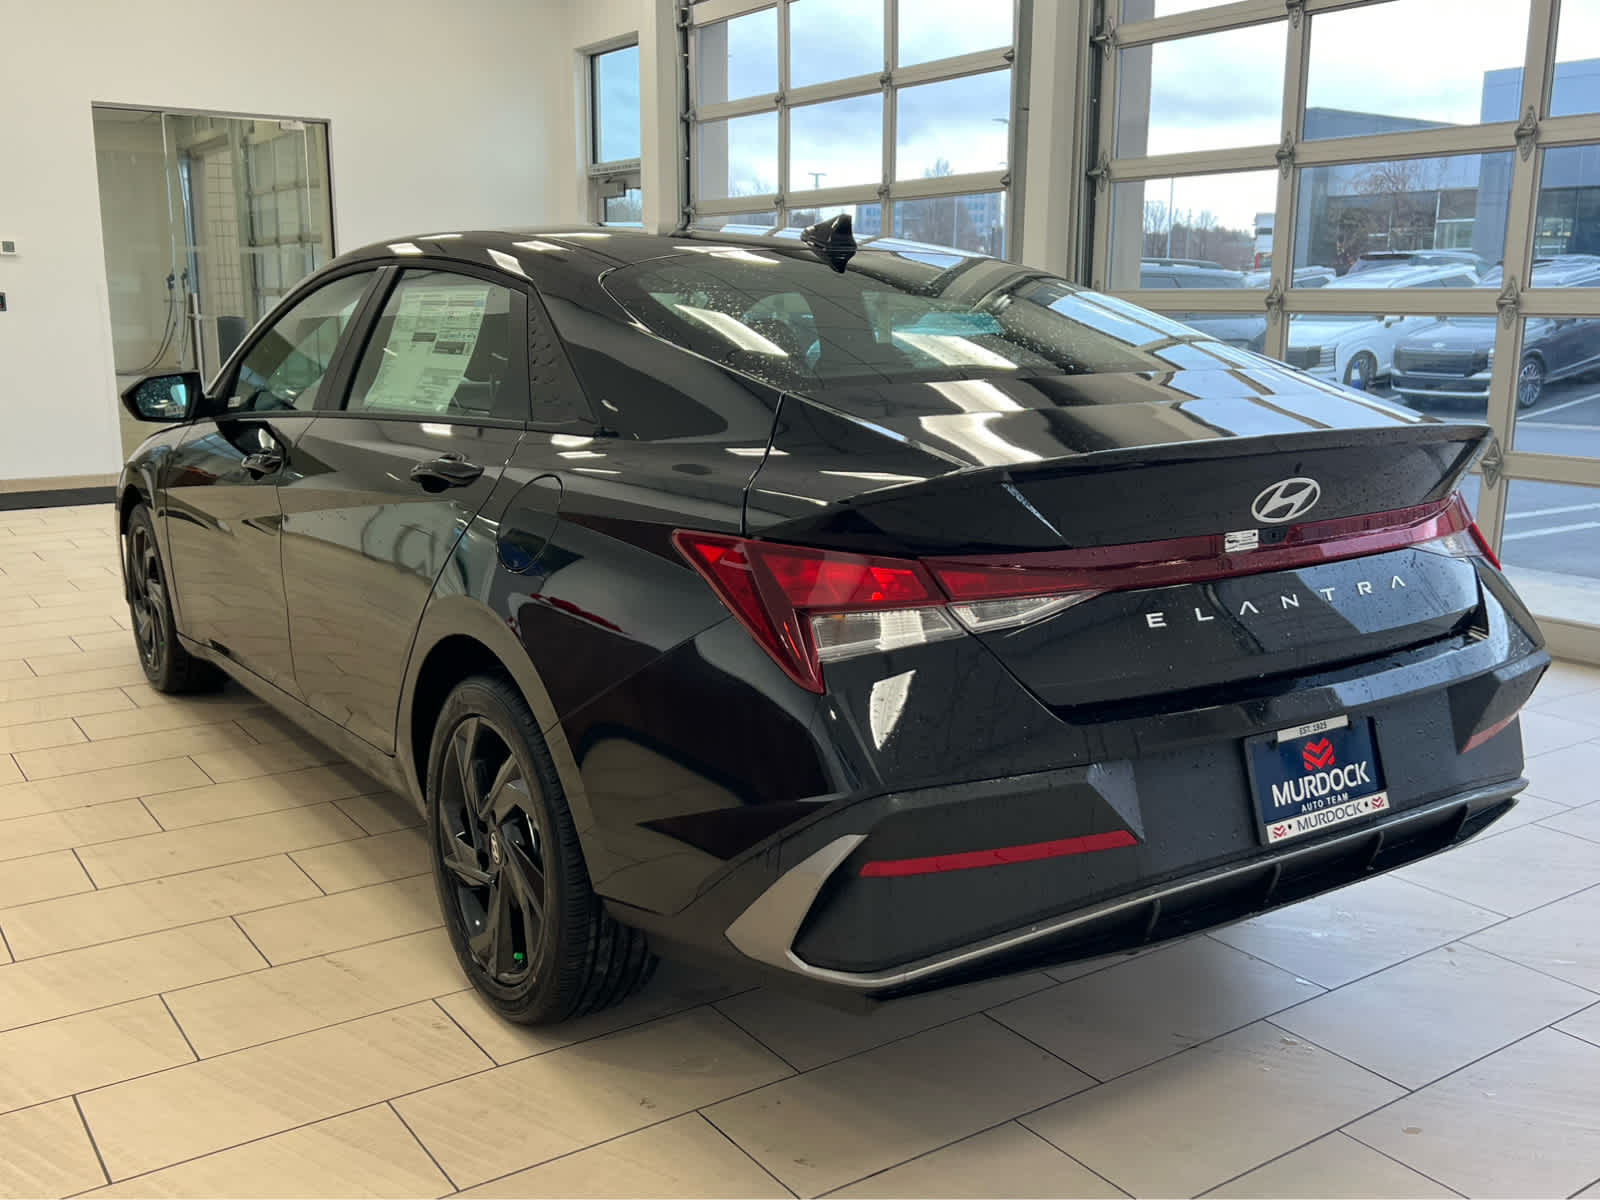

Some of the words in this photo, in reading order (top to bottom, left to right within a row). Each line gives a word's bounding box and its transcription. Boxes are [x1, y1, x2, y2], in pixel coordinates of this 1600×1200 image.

[1146, 575, 1406, 628] ELANTRA
[1272, 761, 1370, 807] MURDOCK
[1301, 799, 1324, 813] AUTO
[1326, 792, 1349, 805] TEAM
[1297, 801, 1362, 832] MURDOCK
